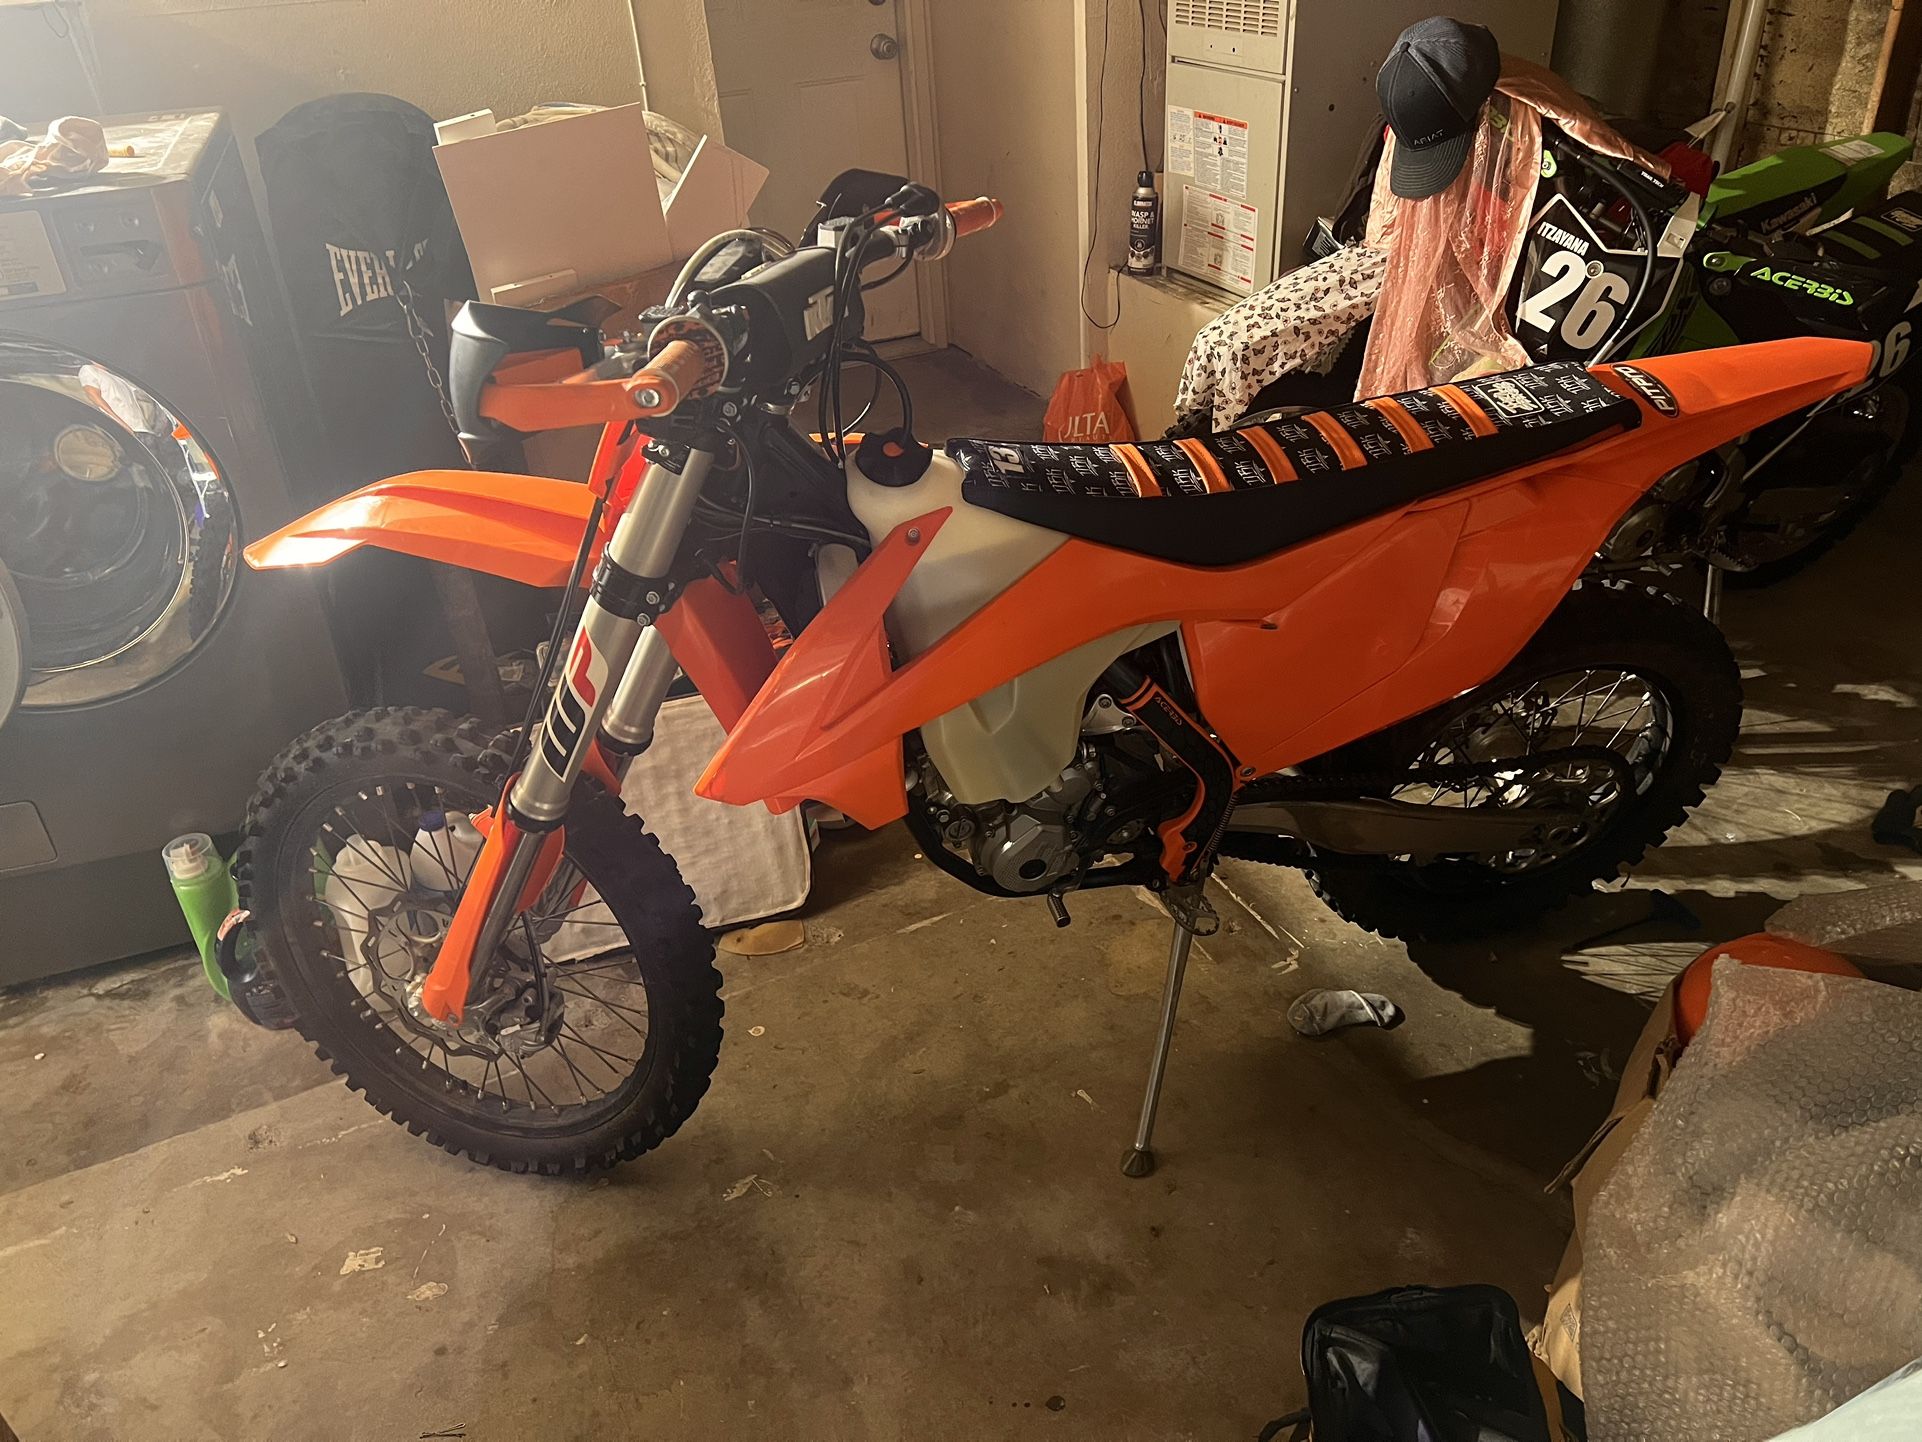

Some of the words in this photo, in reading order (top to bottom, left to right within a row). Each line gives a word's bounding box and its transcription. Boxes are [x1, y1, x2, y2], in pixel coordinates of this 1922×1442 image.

[1413, 128, 1444, 146] ARIAT
[1760, 192, 1817, 234] Kawasaki
[1536, 221, 1590, 257] ITZAYANA
[1517, 250, 1630, 350] 26
[1750, 266, 1854, 306] ACERBIS
[989, 444, 1025, 474] 13
